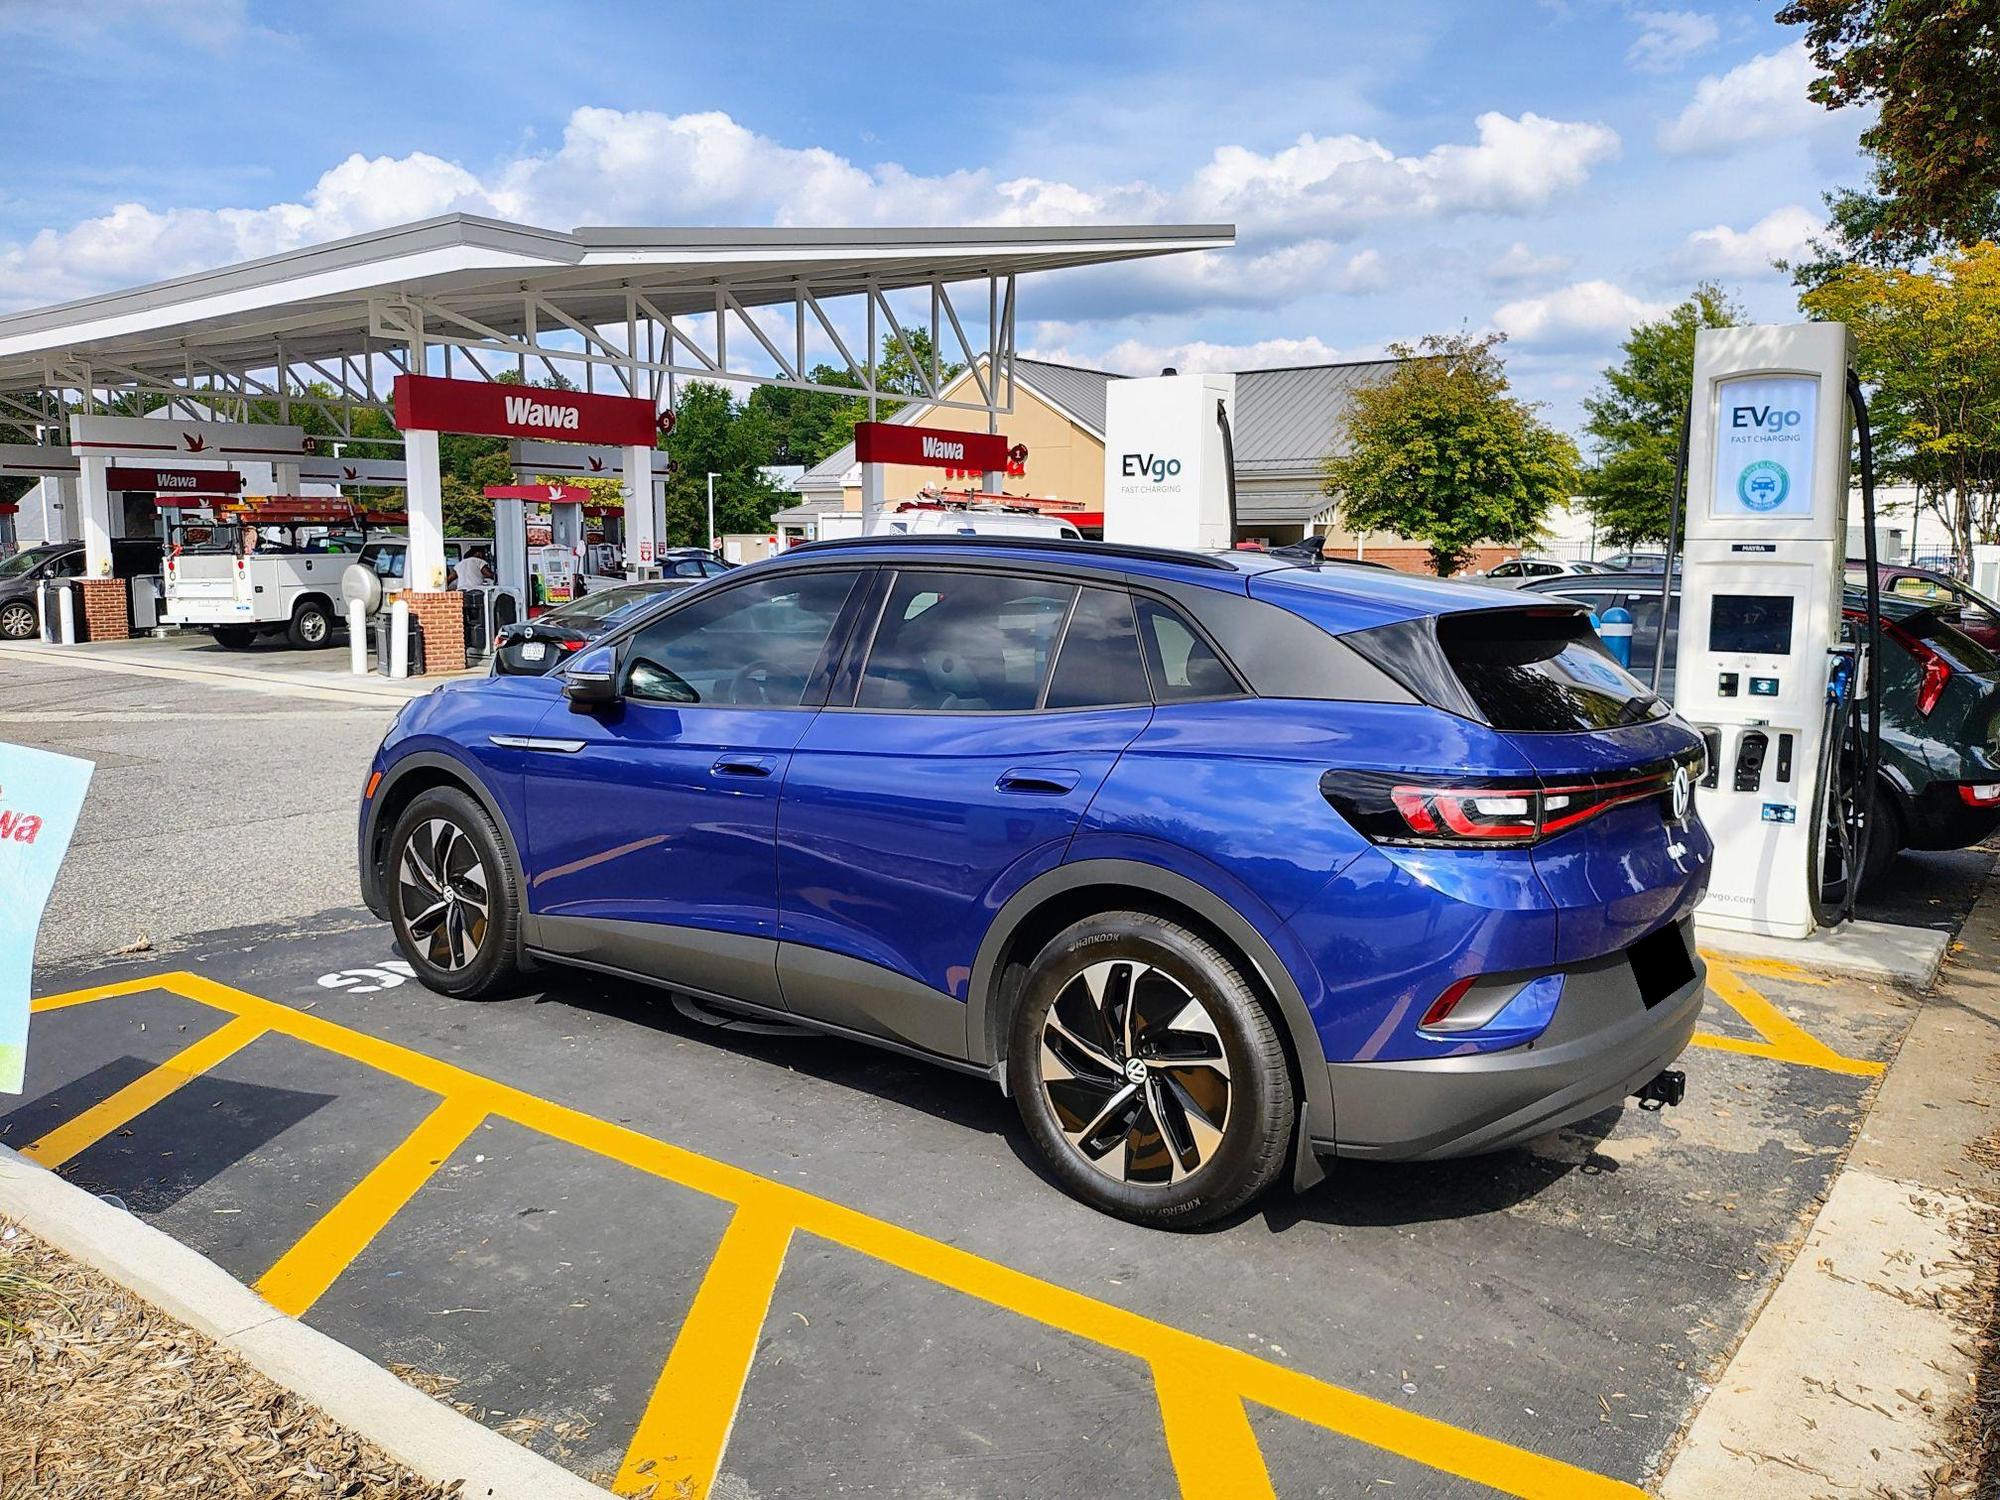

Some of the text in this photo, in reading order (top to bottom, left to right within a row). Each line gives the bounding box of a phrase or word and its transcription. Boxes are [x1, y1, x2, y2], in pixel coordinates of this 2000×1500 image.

[505, 396, 579, 430] Wawa
[663, 417, 670, 428] 9
[1732, 405, 1801, 433] EVgo
[922, 436, 964, 460] Wawa
[1753, 434, 1801, 443] CHARGING
[1122, 453, 1182, 483] EVgo
[156, 473, 197, 488] Wawa
[1121, 485, 1181, 494] FAST CHARGING
